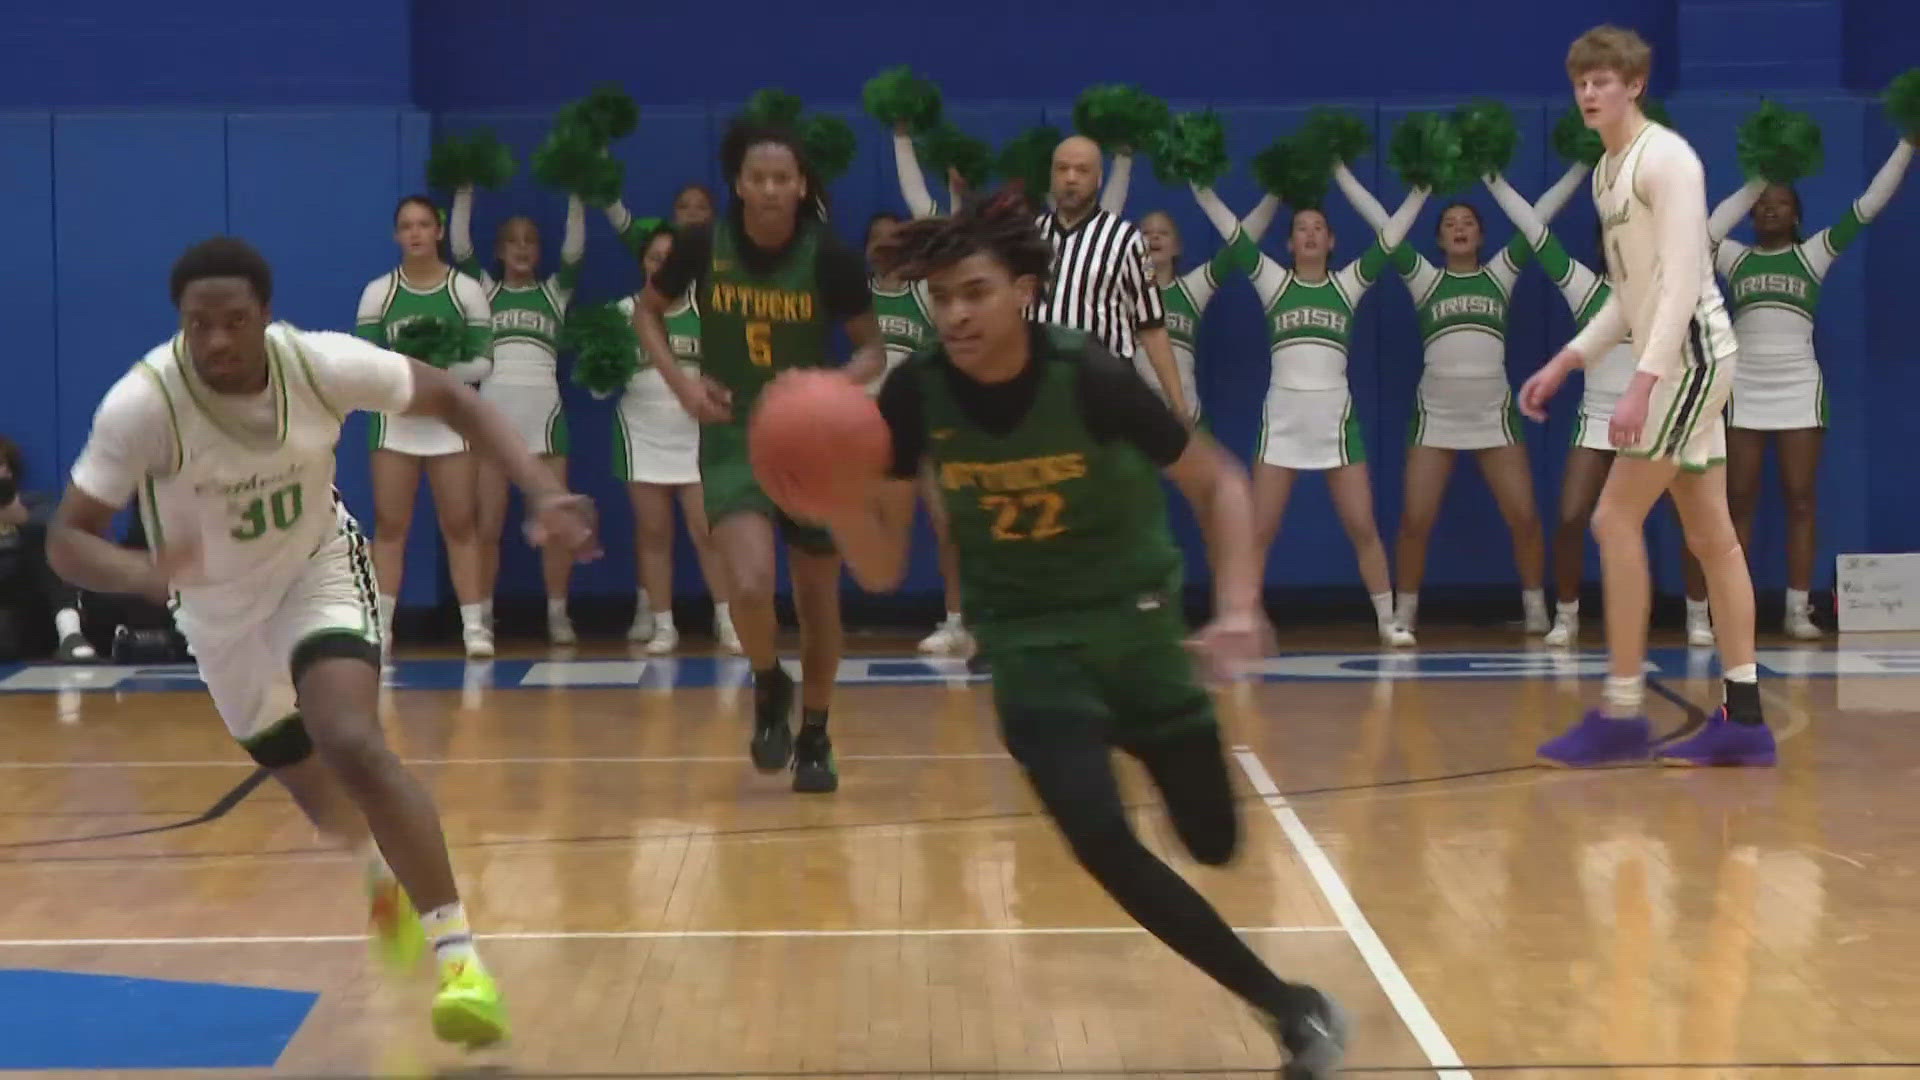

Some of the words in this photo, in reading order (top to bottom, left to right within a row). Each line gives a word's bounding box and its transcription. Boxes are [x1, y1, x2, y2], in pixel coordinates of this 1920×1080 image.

[1734, 274, 1806, 300] IRISH
[1274, 306, 1346, 333] IRISH
[1431, 295, 1503, 321] IRISH
[492, 308, 555, 339] RISH
[878, 314, 923, 342] ISH
[229, 482, 303, 541] 30
[978, 492, 1070, 540] 22
